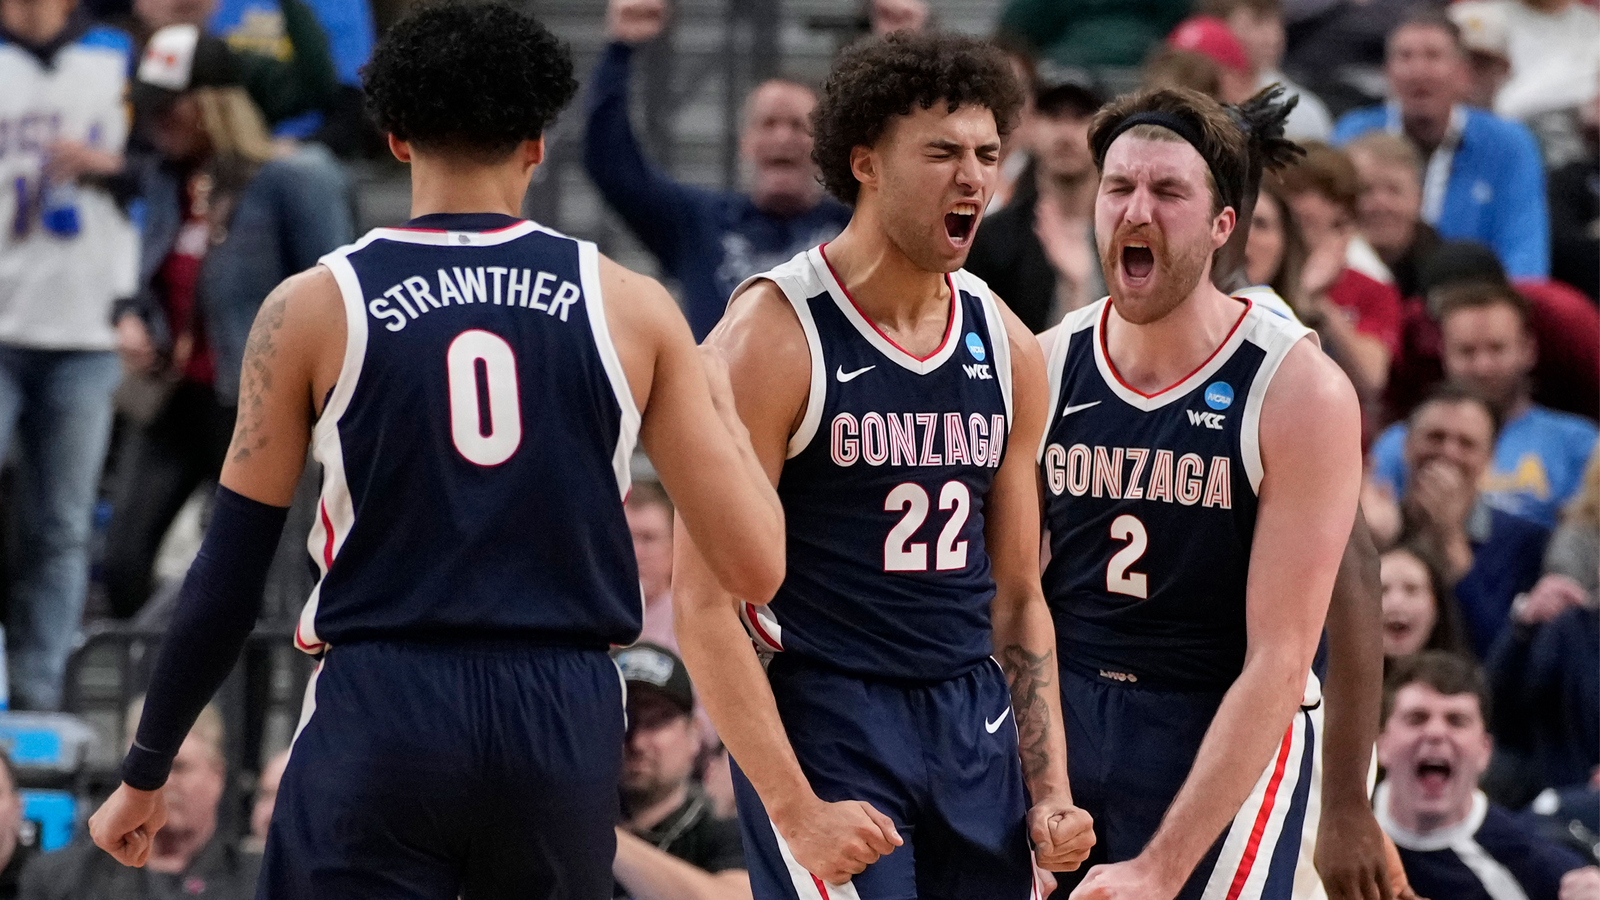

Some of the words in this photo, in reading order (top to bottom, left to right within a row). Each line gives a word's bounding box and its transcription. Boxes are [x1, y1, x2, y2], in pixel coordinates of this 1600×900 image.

[369, 266, 580, 332] STRAWTHER
[447, 328, 522, 467] 0
[962, 364, 993, 379] WCC
[830, 411, 1005, 468] GONZAGA
[1186, 409, 1226, 430] WCC
[1045, 443, 1232, 509] GONZAGA
[884, 479, 971, 573] 22
[1106, 514, 1148, 599] 2
